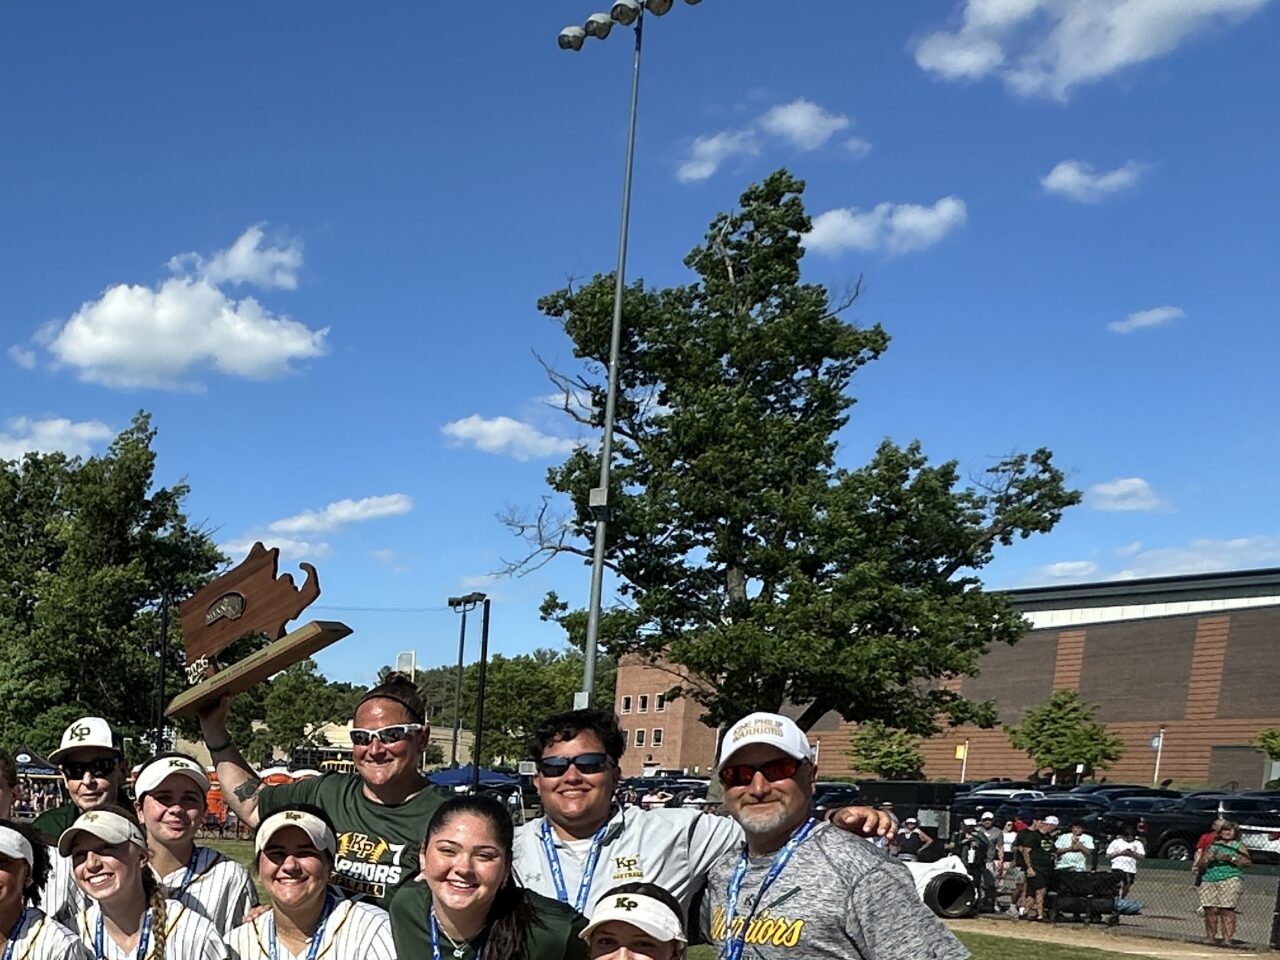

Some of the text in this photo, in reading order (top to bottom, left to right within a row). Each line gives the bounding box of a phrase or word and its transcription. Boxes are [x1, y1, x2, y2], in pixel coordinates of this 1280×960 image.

[69, 723, 91, 741] KP
[350, 833, 376, 858] KP
[615, 857, 637, 871] KP
[615, 897, 638, 911] KP
